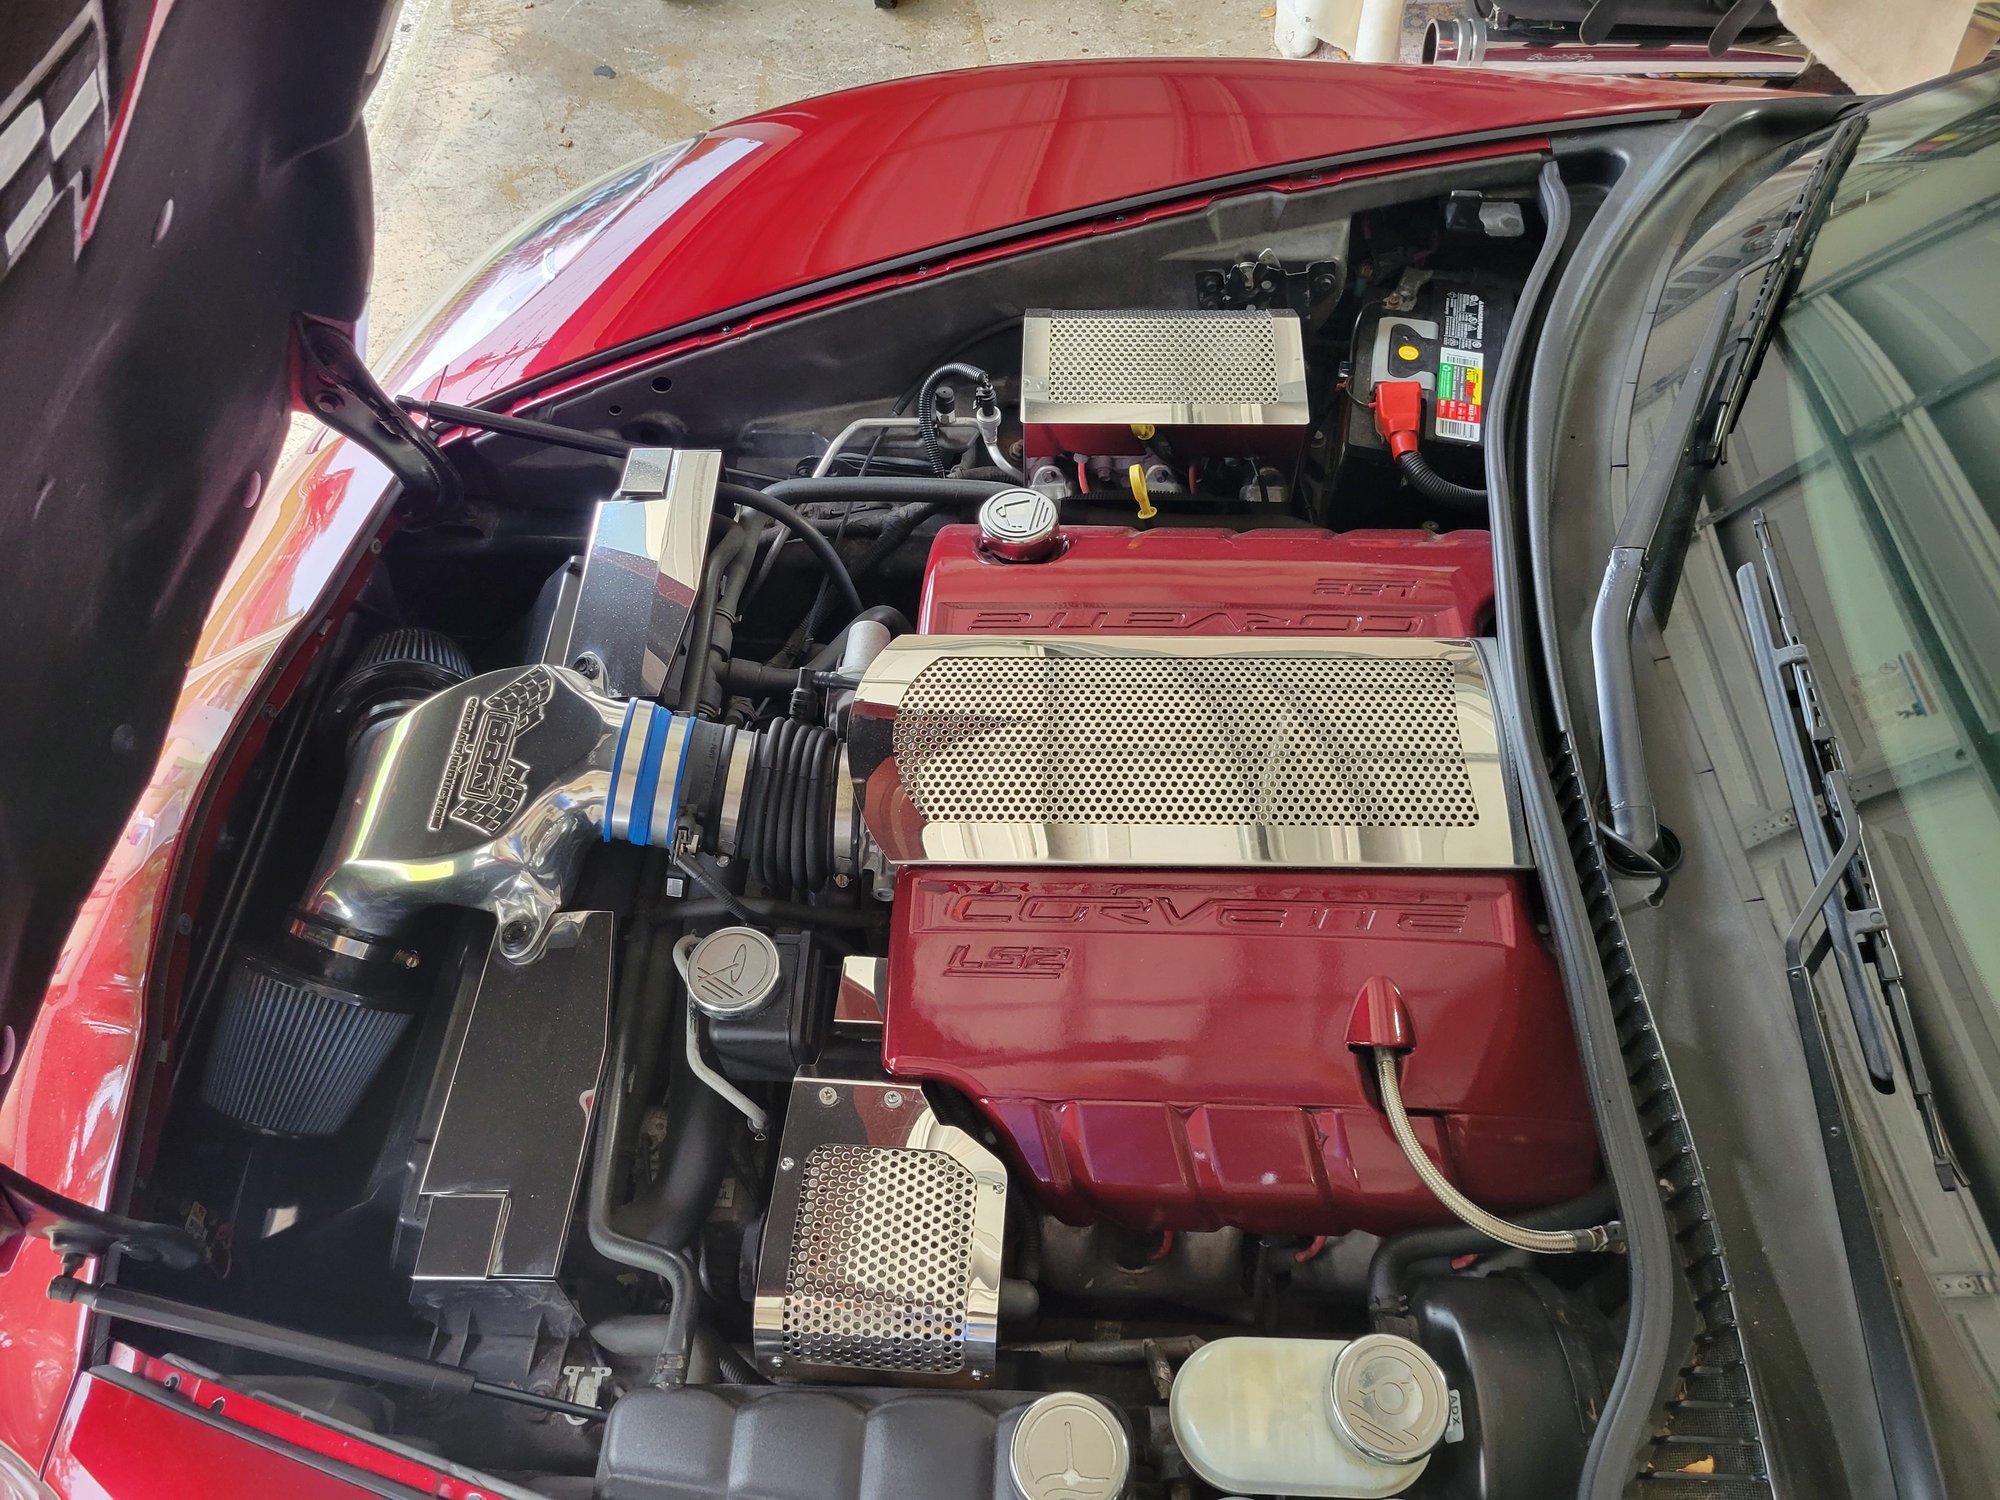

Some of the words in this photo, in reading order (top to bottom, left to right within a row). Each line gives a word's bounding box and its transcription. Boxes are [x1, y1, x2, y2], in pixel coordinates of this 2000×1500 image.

[1312, 582, 1418, 598] LS2
[968, 612, 1423, 633] CORVETTE
[459, 698, 478, 730] COLD
[452, 731, 469, 754] AIR
[470, 719, 514, 794] BBK
[429, 755, 462, 829] INDUCTION
[951, 894, 1469, 933] CORVETTE
[947, 944, 1070, 969] LS2
[1449, 1395, 1461, 1426] ADX
